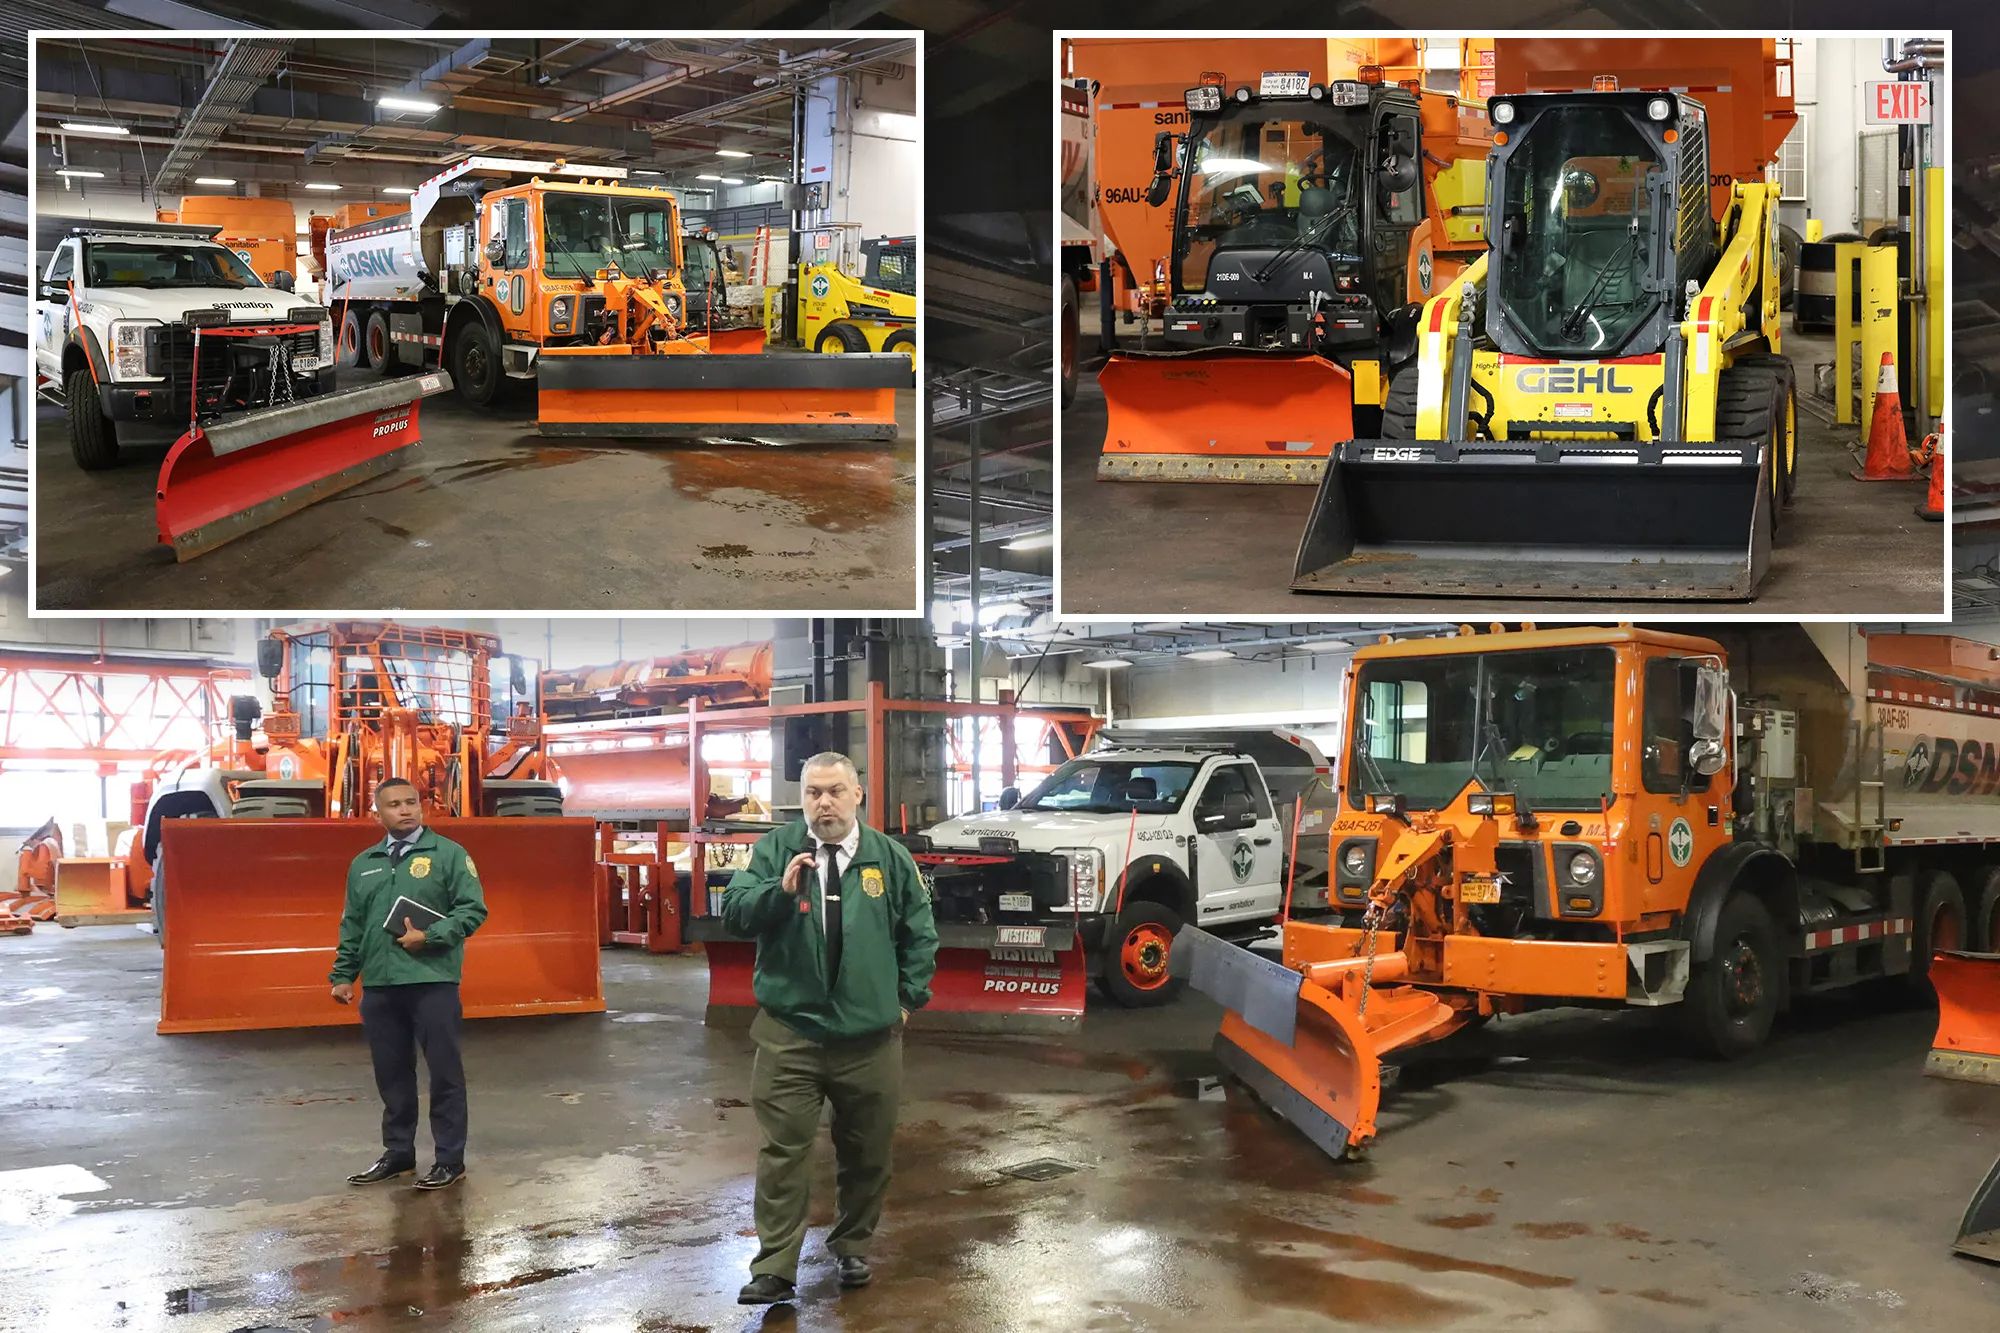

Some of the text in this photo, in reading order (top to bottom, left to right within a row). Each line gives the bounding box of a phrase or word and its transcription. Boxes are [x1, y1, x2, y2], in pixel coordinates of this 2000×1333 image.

[1286, 77, 1306, 91] 4182
[1877, 84, 1922, 119] EXIT
[225, 241, 260, 249] sanitation
[346, 246, 398, 278] DSNY
[1303, 271, 1313, 280] M.4
[212, 301, 274, 310] sanitation
[863, 293, 890, 305] SANITATION
[1516, 367, 1633, 394] GEHL
[372, 419, 409, 438] PRO PLUS
[1373, 447, 1422, 461] EDGE
[960, 827, 1016, 838] sanitation
[1333, 819, 1383, 832] 38AF-051
[1228, 899, 1256, 911] sanitation
[1000, 928, 1042, 944] WESTERN
[984, 980, 1060, 995] PRO PLUS
